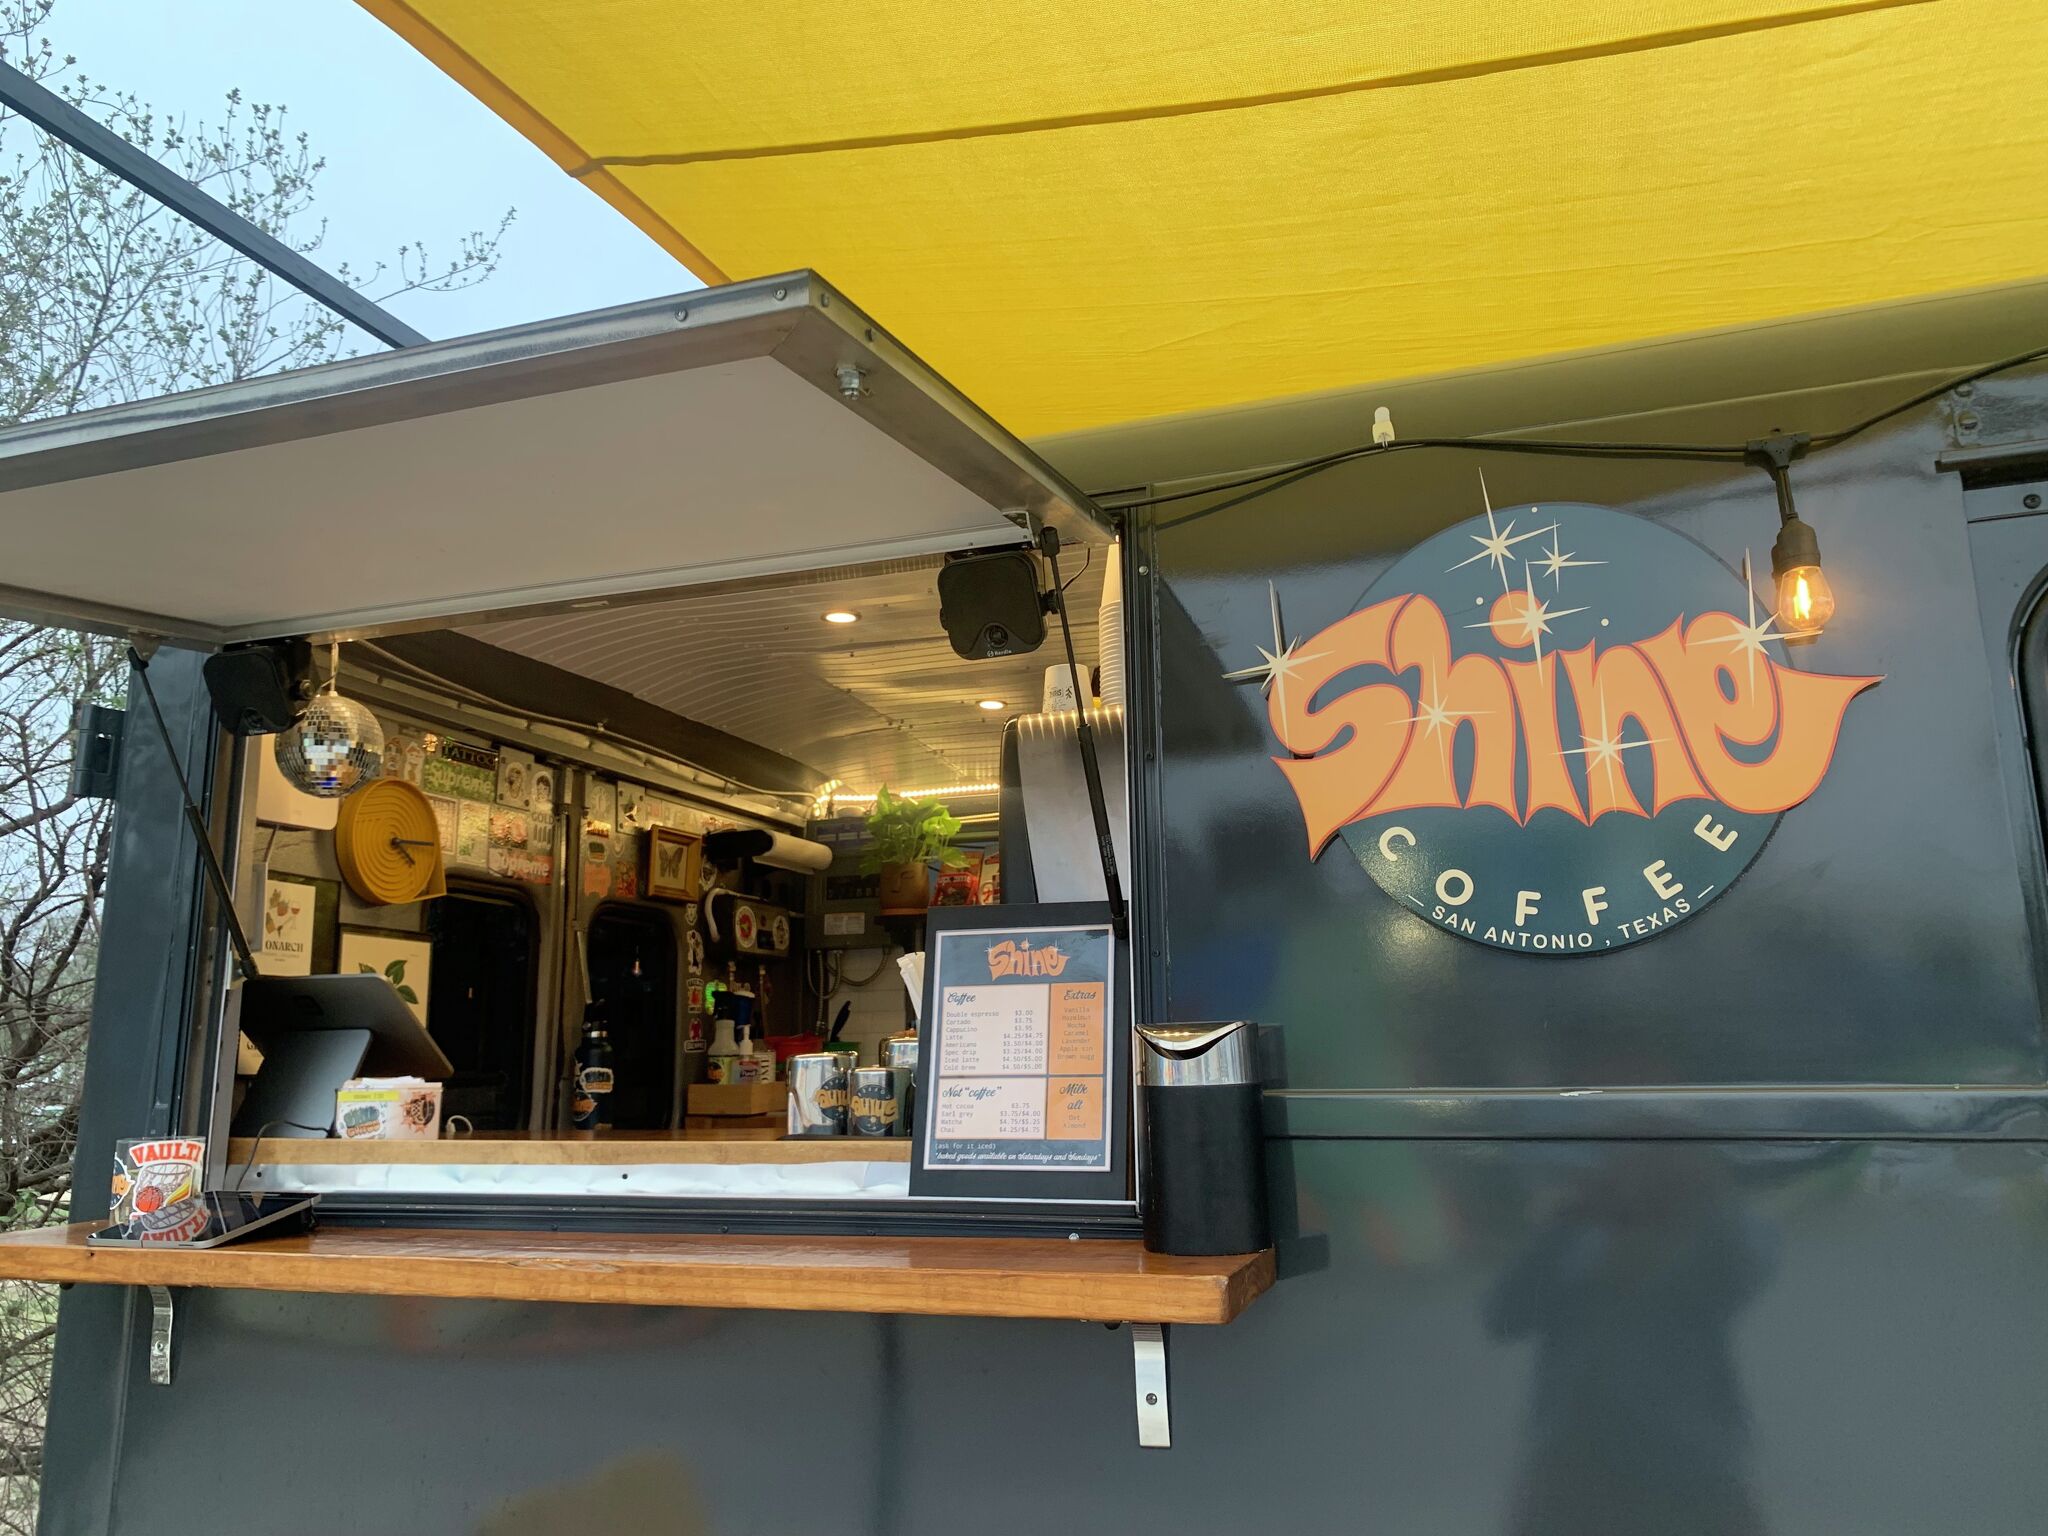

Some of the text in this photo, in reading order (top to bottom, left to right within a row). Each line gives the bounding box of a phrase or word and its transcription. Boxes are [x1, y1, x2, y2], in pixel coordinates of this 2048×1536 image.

[1268, 589, 1887, 863] Shine
[431, 760, 491, 793] Supreme
[1379, 813, 1738, 926] COFFEE
[1432, 905, 1477, 934] SAN
[1618, 898, 1690, 939] TEXAS
[265, 940, 303, 952] ONARCH
[988, 939, 1071, 981] Shine
[947, 992, 976, 1006] Coffee
[1064, 990, 1096, 1000] Extras
[942, 1084, 964, 1098] Not
[1060, 1083, 1088, 1096] Milk
[1067, 1100, 1084, 1110] alt
[934, 1142, 950, 1150] (ask
[978, 1142, 996, 1150] iced)
[957, 1154, 976, 1162] goods
[978, 1152, 1007, 1160] available
[1018, 1152, 1052, 1164] Saturdays
[1054, 1152, 1068, 1160] and
